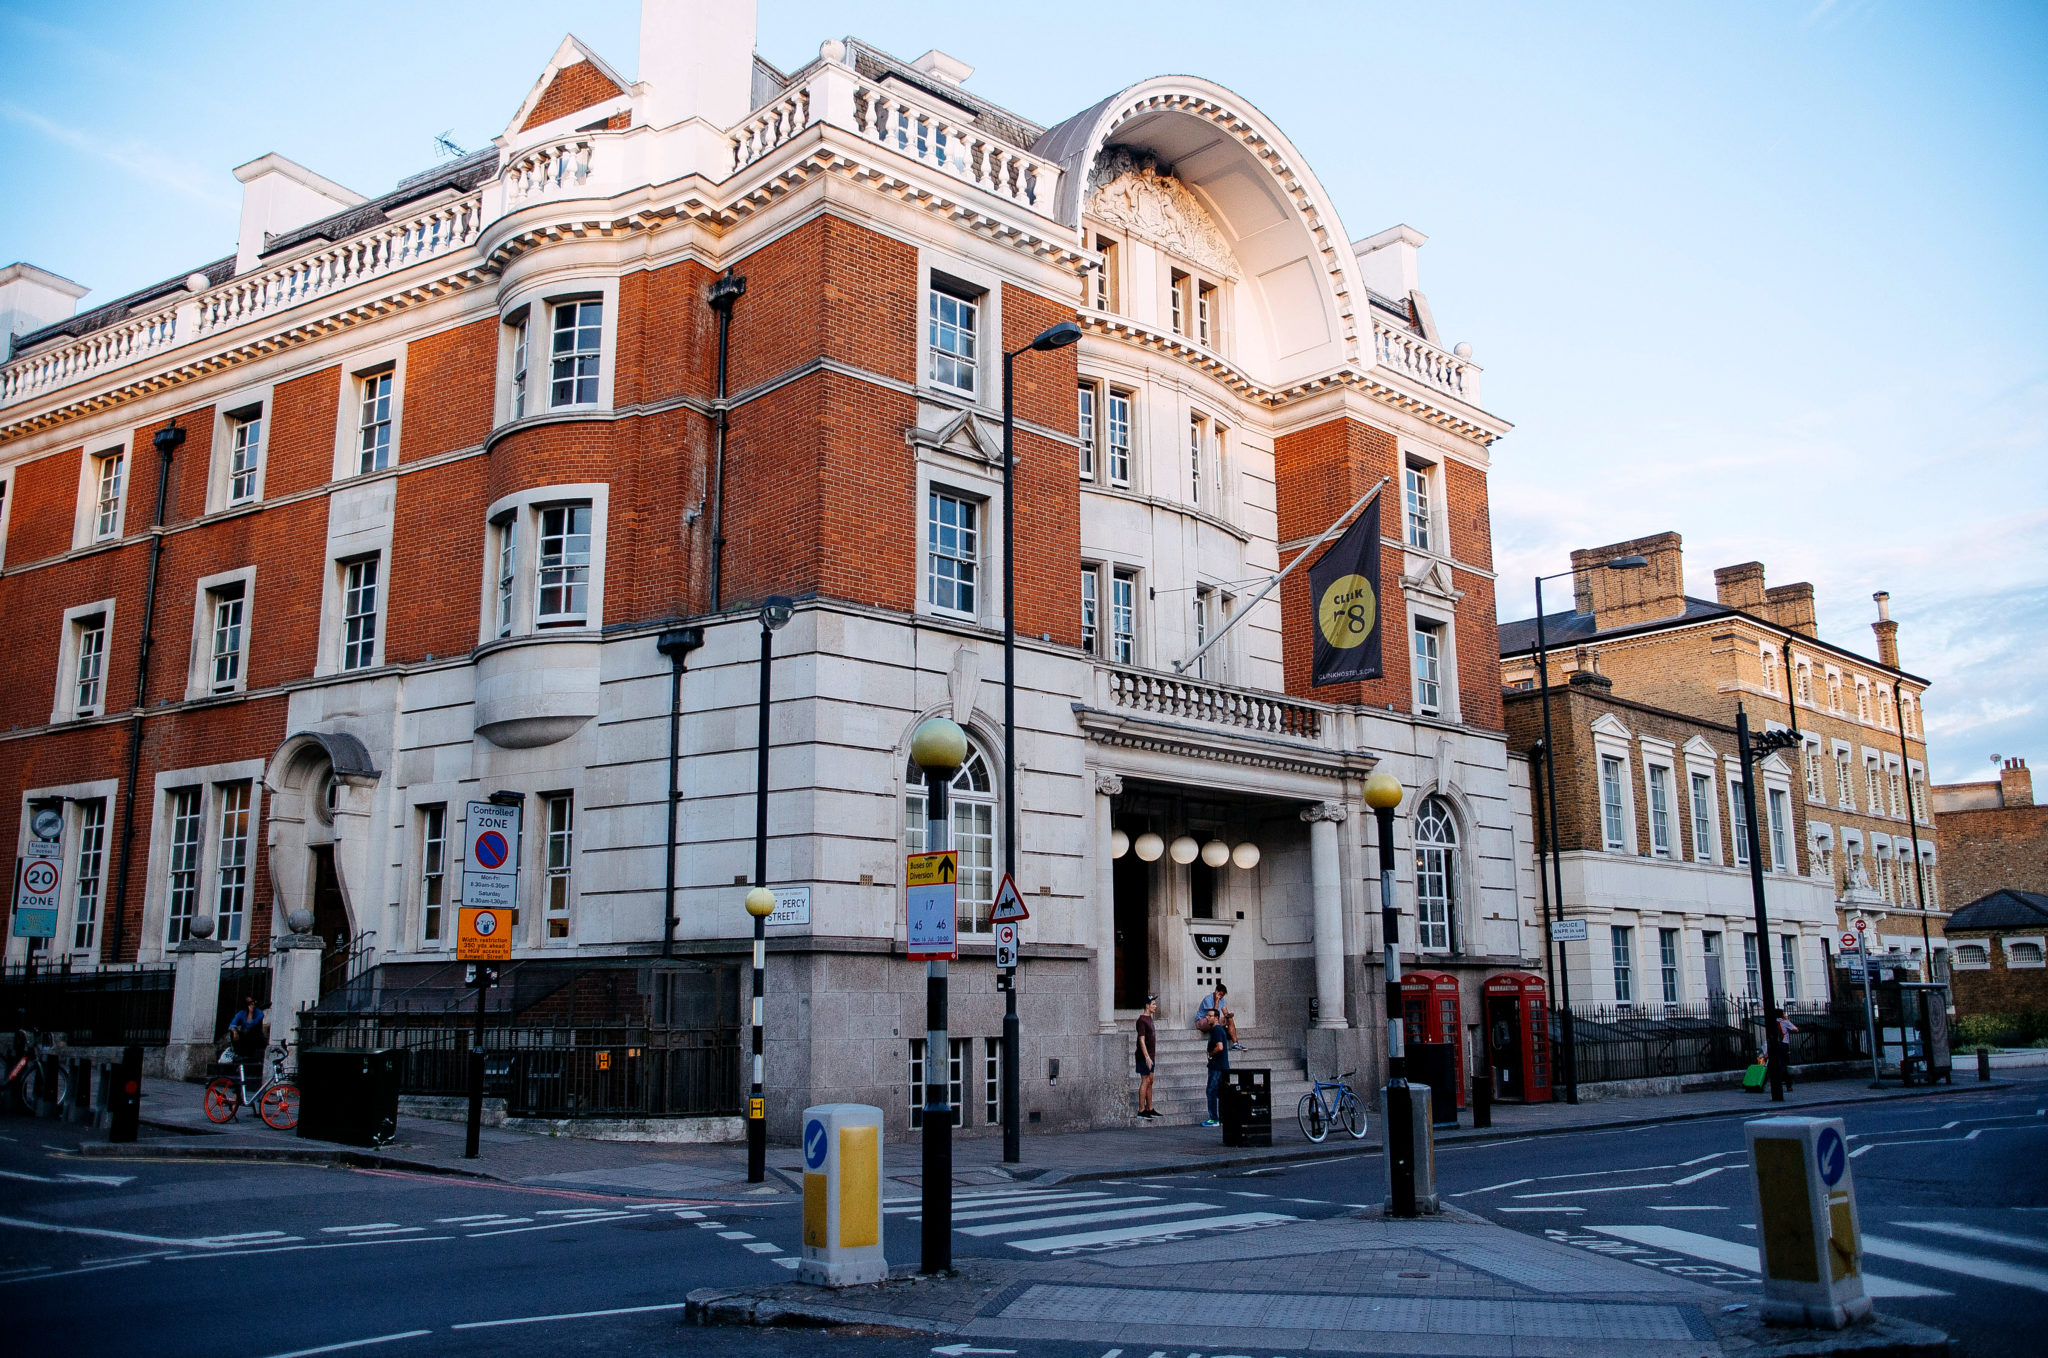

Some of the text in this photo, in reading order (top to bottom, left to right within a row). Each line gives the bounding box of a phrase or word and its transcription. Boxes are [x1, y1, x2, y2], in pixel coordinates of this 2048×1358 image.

[473, 805, 514, 817] Controlled
[478, 817, 508, 829] ZONE
[910, 862, 925, 870] Buses
[30, 871, 53, 884] 20
[909, 872, 934, 880] Diversion
[22, 896, 54, 905] ZONE
[782, 898, 806, 909] PERCY
[926, 899, 935, 911] 17
[767, 911, 796, 922] STREET
[914, 919, 947, 931] 45 46
[1074, 1233, 1196, 1251] LOOK
[1547, 1235, 1658, 1255] LOOK
